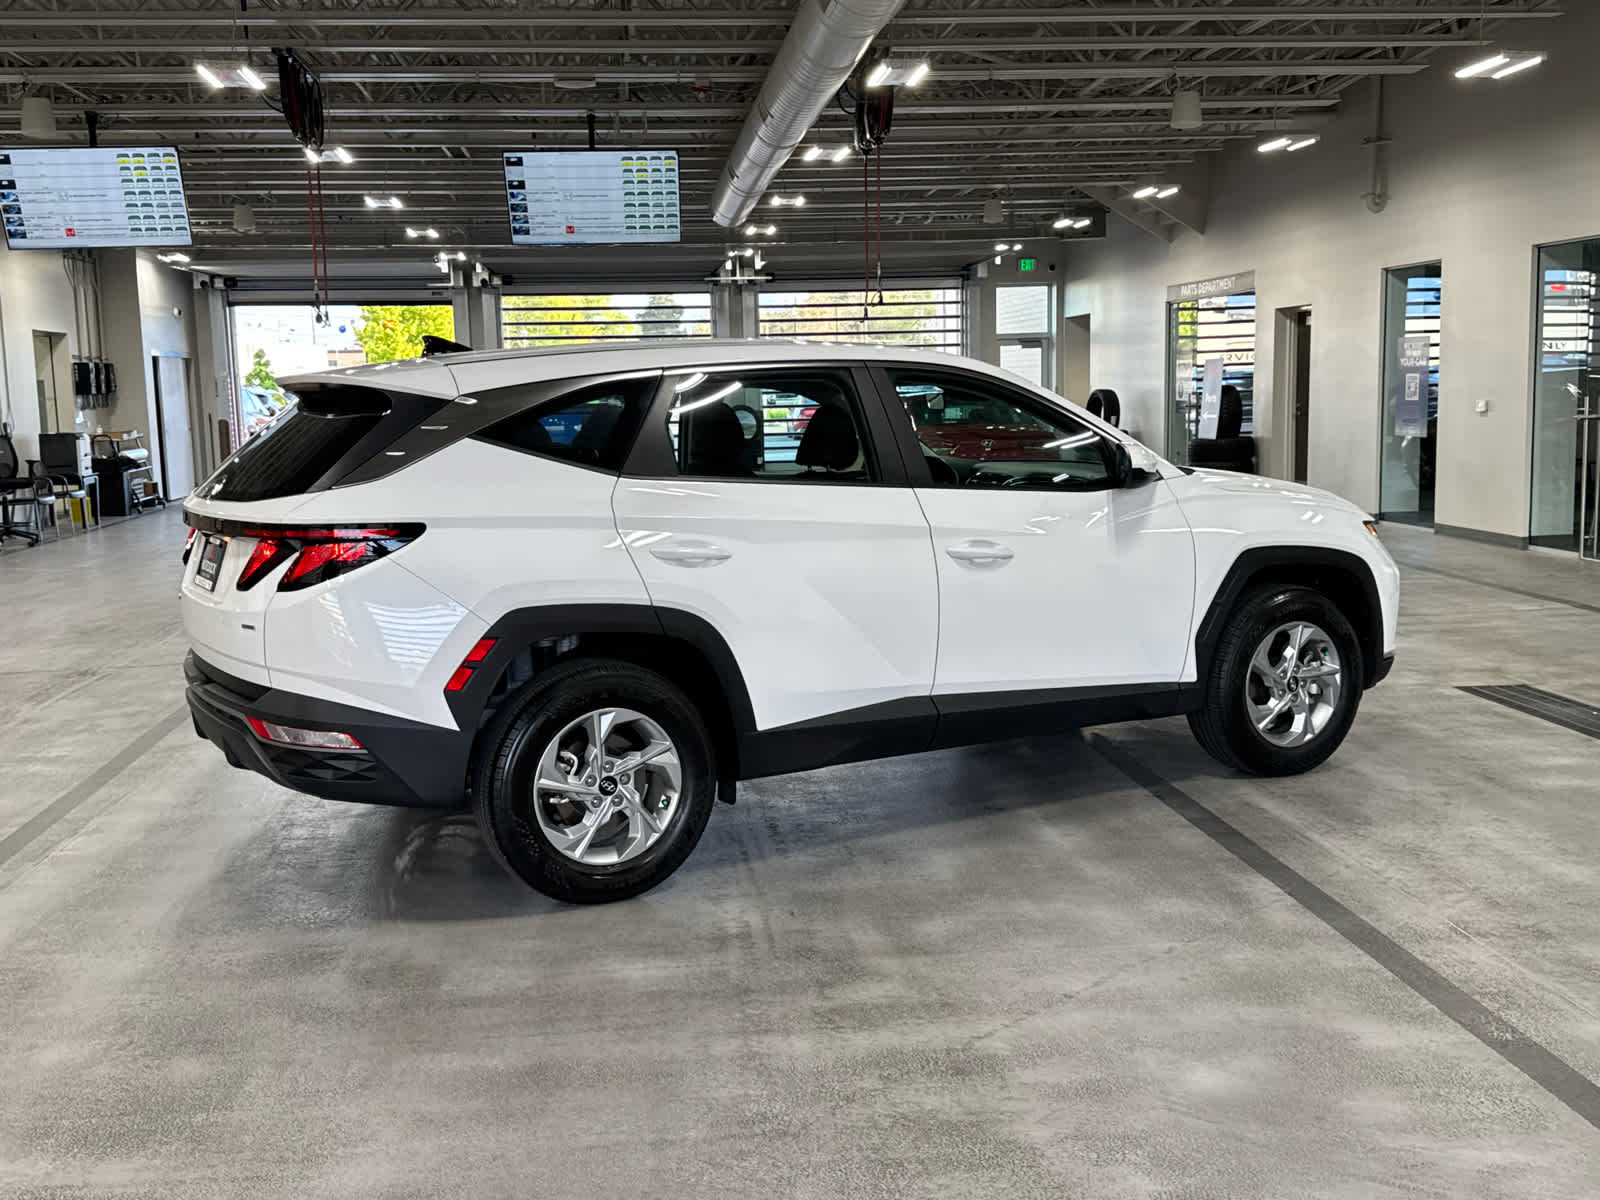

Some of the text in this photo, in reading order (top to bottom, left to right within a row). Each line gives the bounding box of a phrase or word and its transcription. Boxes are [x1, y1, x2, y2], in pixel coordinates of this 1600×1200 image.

[1180, 276, 1236, 297] PARTS DEPARTMENT
[1542, 342, 1567, 350] NLY
